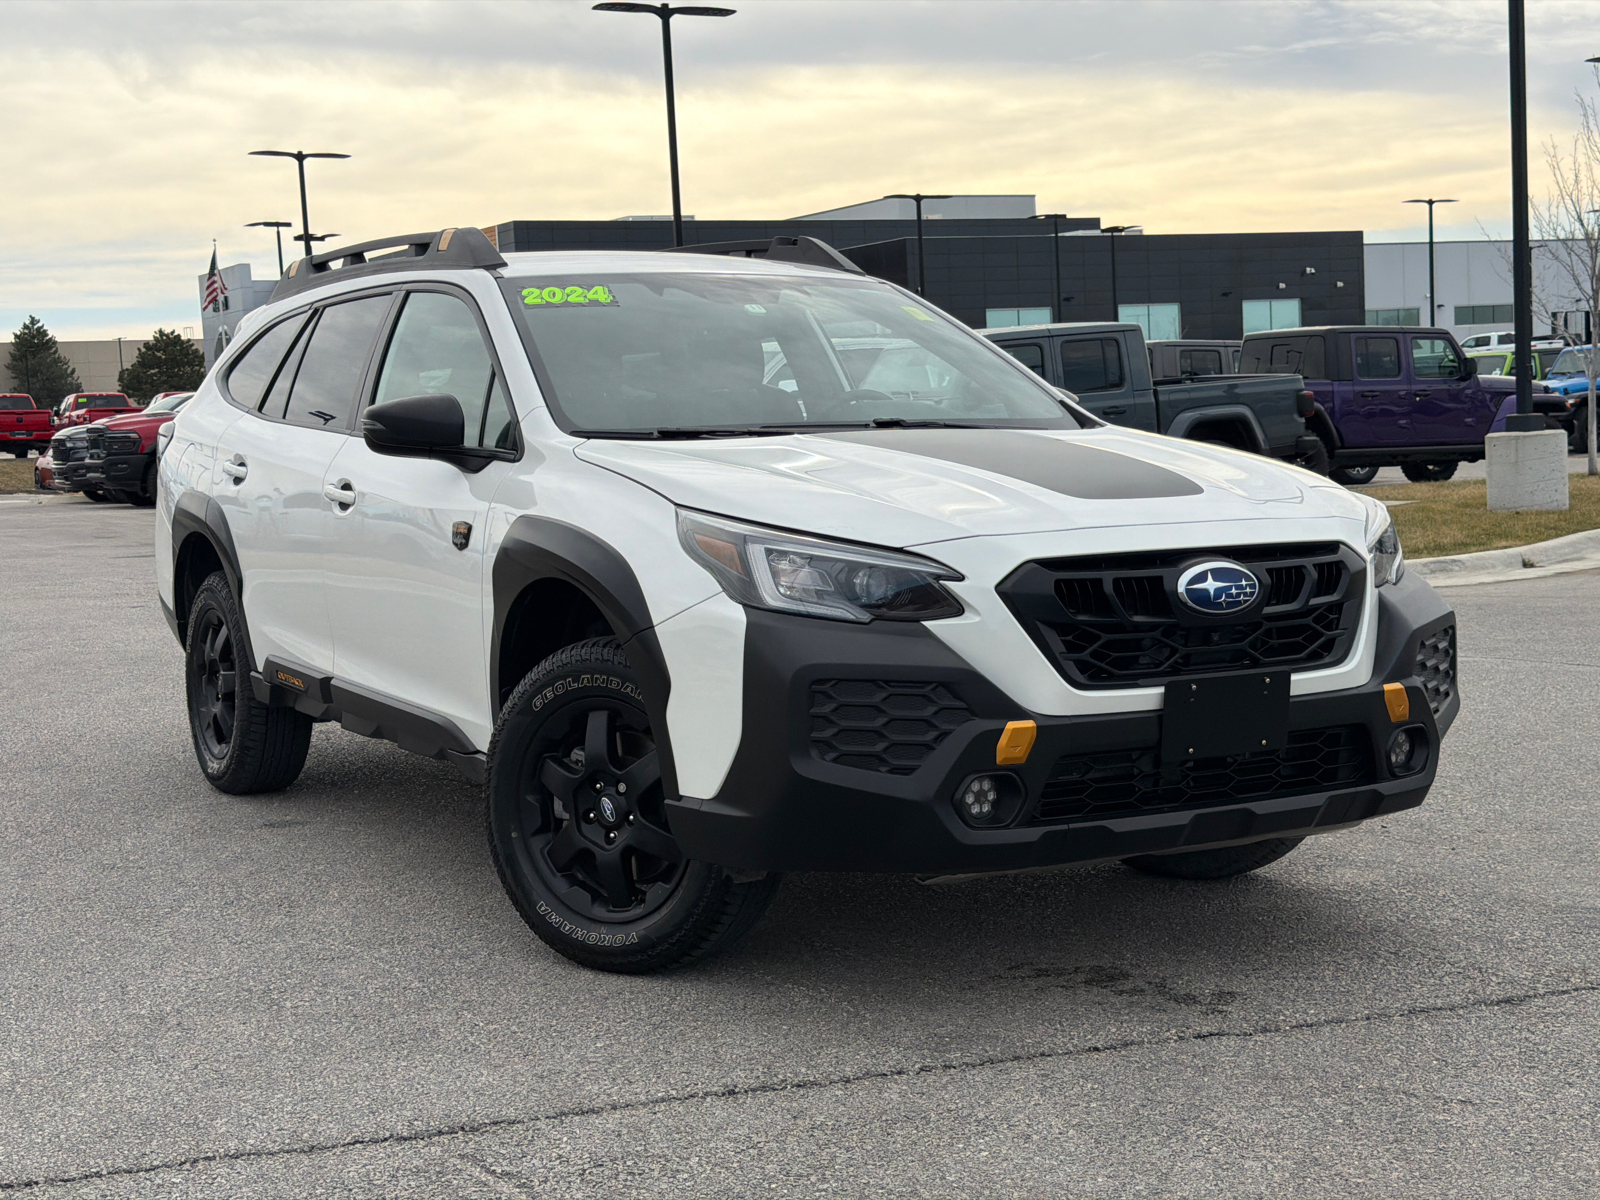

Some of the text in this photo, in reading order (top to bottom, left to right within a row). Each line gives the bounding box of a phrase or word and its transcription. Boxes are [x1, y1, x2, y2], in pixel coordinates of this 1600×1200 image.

[521, 286, 613, 305] 2024
[277, 671, 304, 688] OUTBACK
[536, 900, 638, 946] YOKOHAMA
